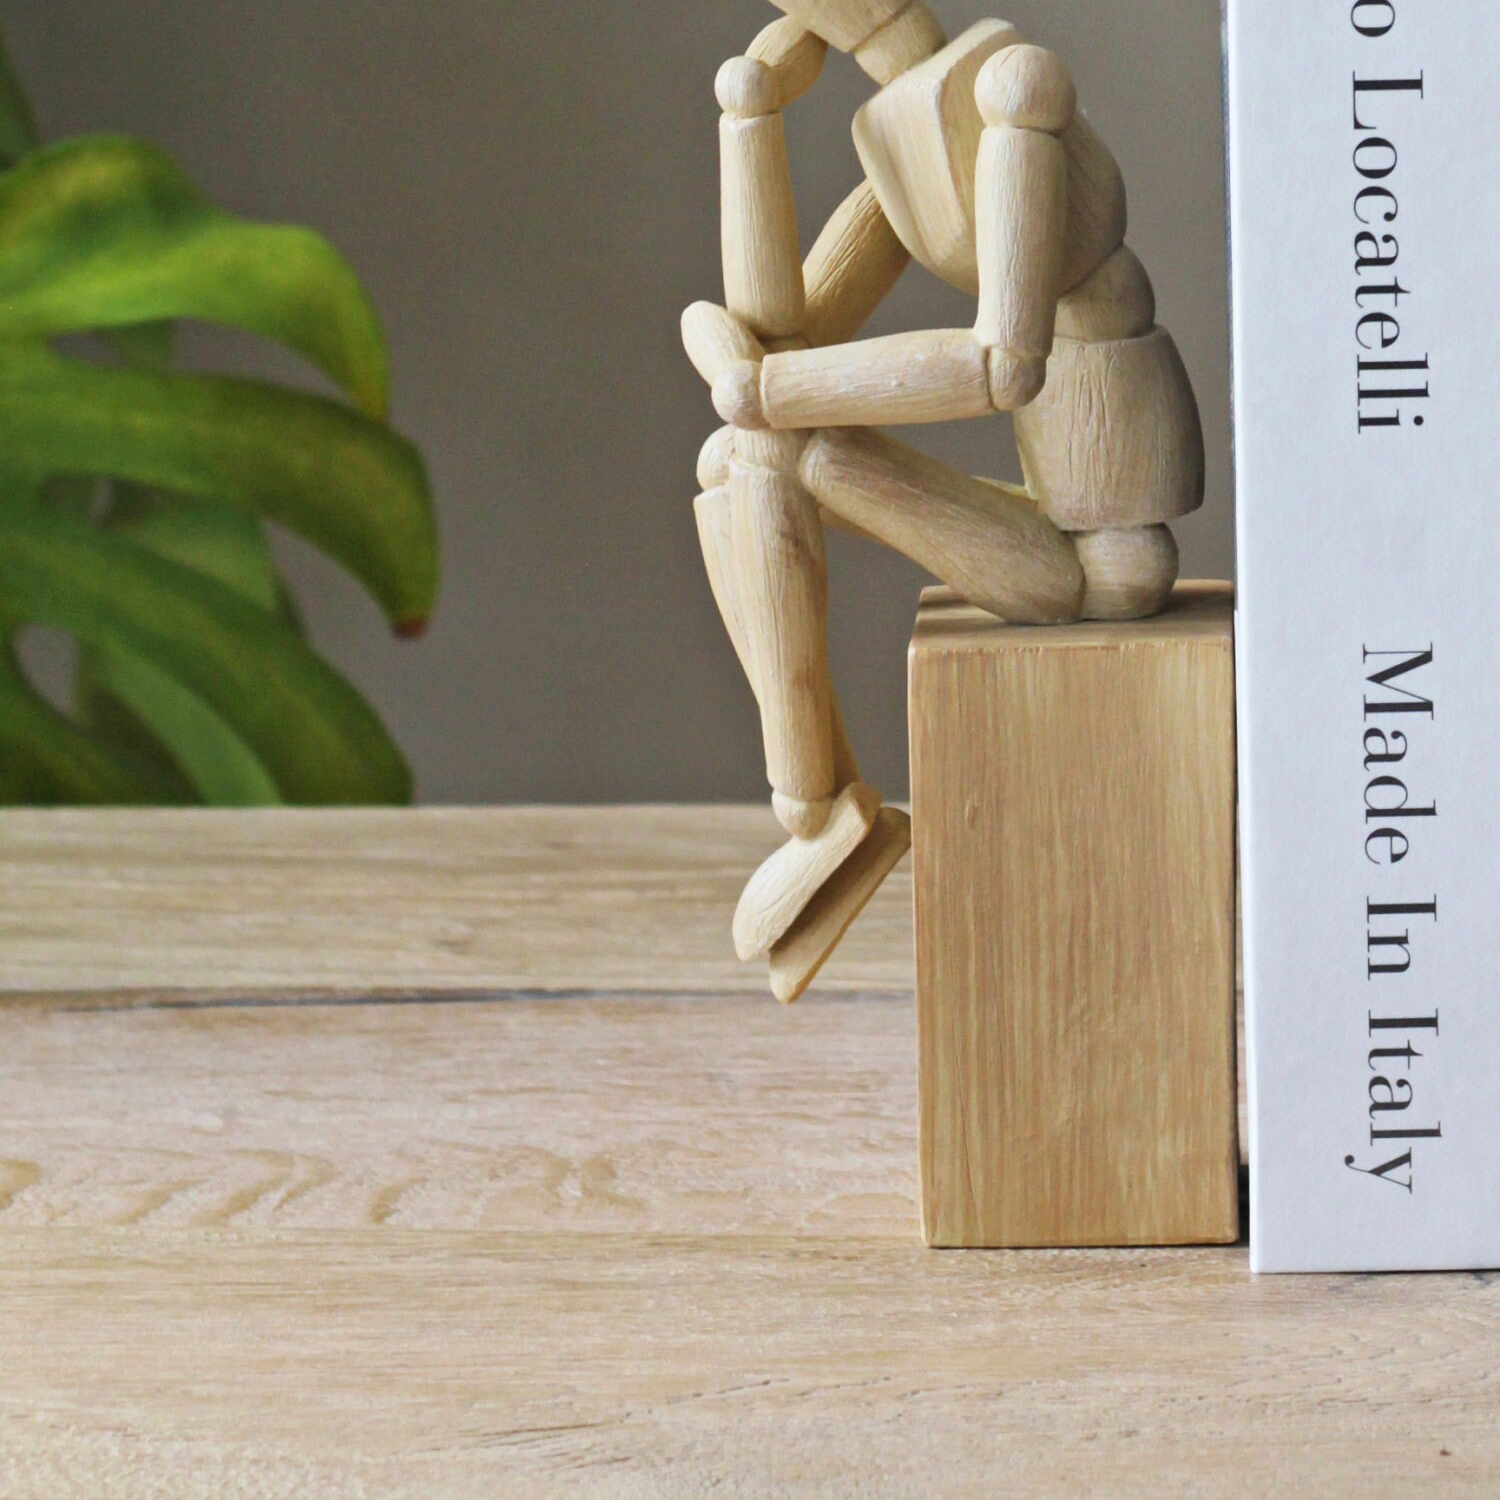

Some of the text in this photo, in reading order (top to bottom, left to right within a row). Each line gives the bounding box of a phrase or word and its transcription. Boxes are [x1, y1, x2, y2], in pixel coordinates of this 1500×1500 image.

[1352, 70, 1430, 434] Locatelli
[1344, 642, 1442, 1193] Made In Italy
